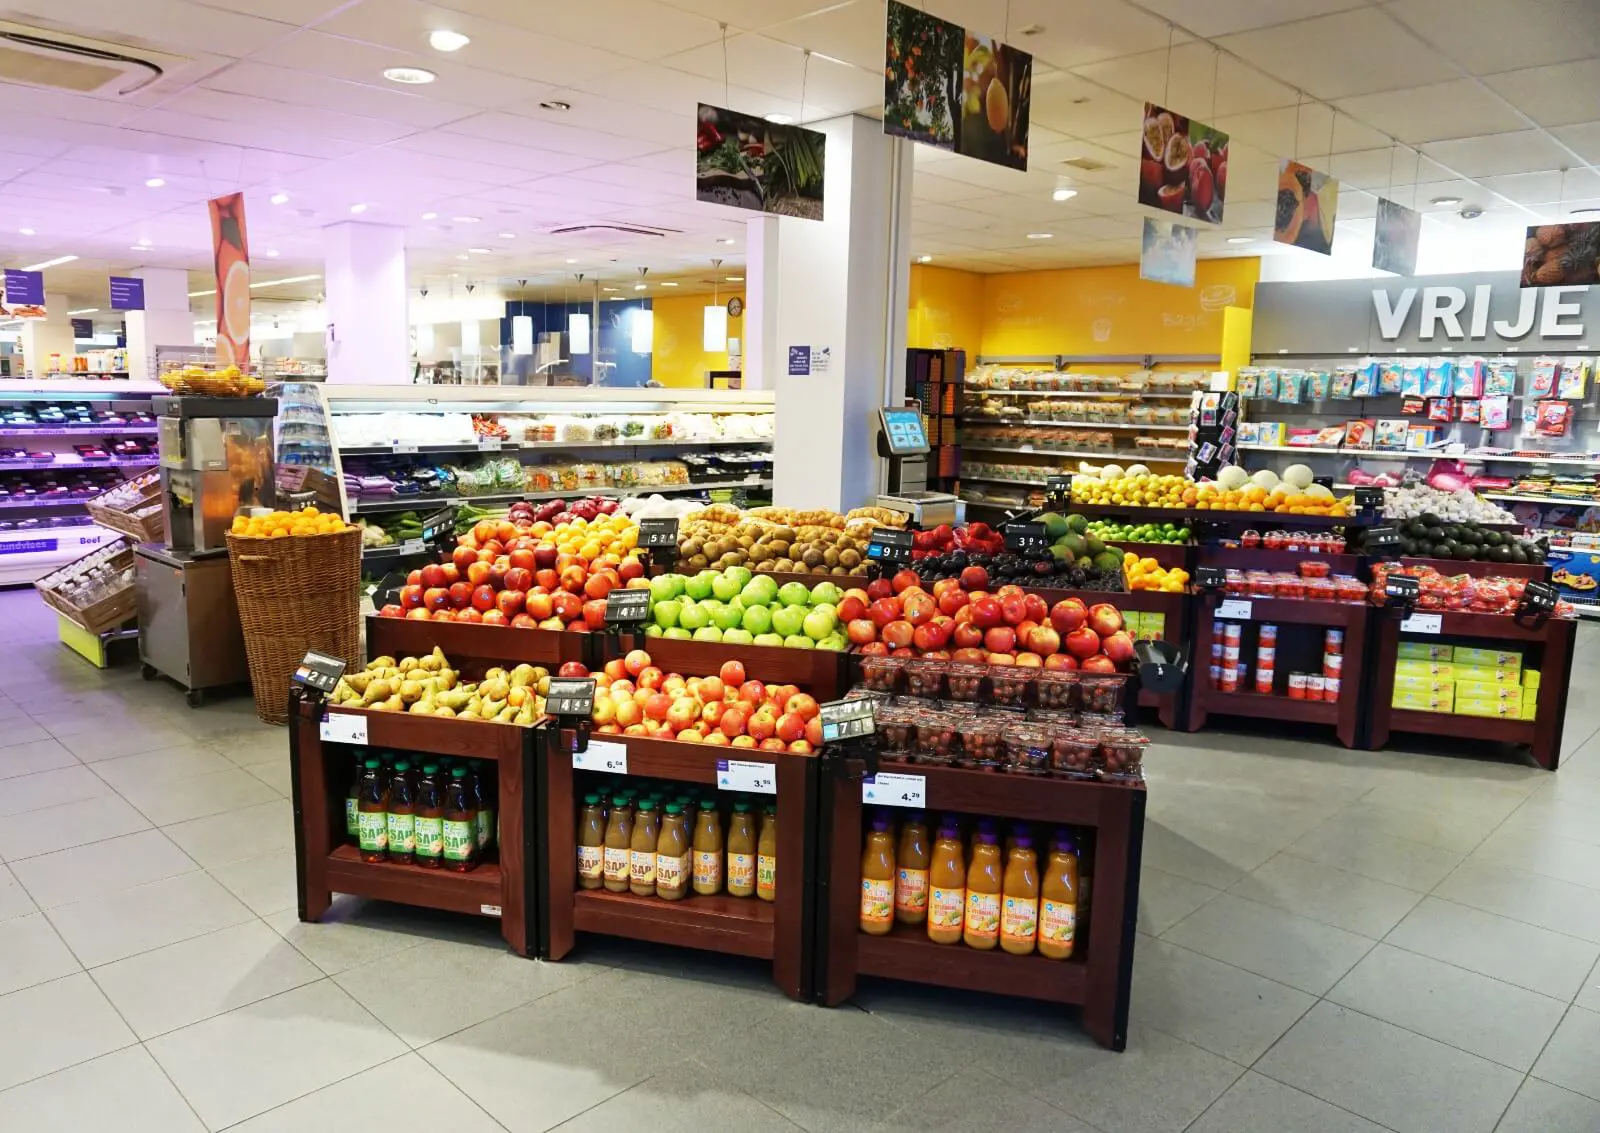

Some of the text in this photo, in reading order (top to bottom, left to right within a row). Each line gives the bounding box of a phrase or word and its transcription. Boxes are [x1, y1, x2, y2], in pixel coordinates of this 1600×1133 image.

[1372, 284, 1589, 340] VRIJE
[80, 536, 101, 544] Beef
[901, 792, 920, 801] 4.29
